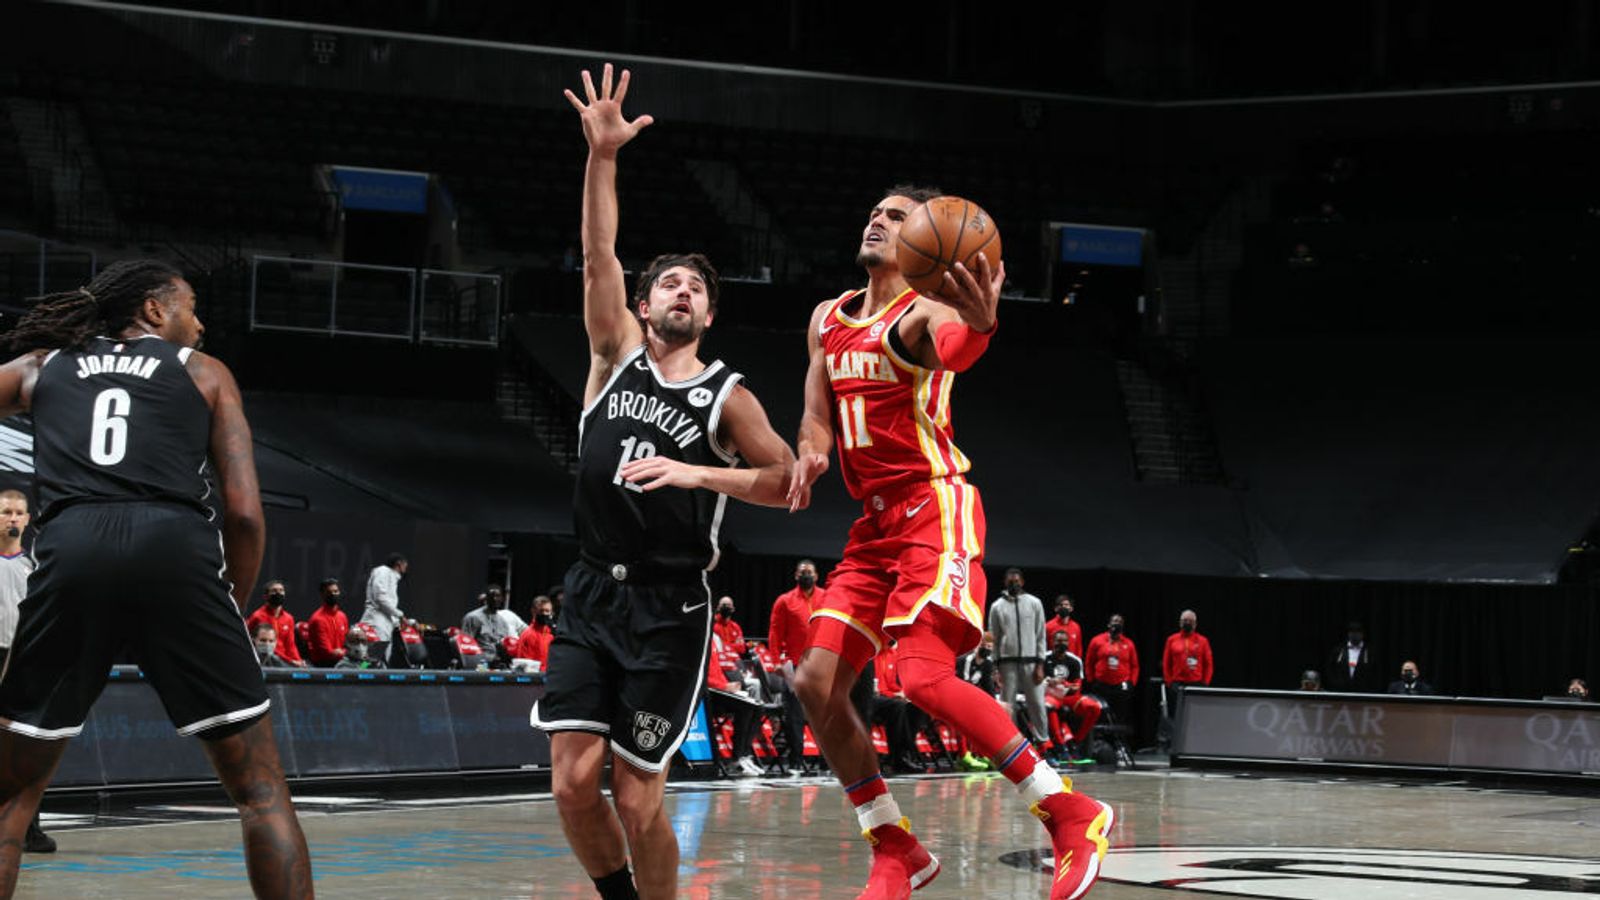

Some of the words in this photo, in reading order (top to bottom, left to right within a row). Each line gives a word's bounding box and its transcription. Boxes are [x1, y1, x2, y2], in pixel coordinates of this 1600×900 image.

[76, 354, 162, 379] JORDAN
[826, 350, 899, 383] LANTA
[90, 387, 131, 466] 6
[608, 390, 702, 450] BROOKLYN
[840, 394, 873, 449] 11
[275, 708, 369, 743] ARCLAYS
[637, 713, 669, 736] NETS
[1246, 701, 1385, 738] QATAR
[1525, 712, 1599, 746] QA
[1277, 735, 1385, 757] AIRWAYS
